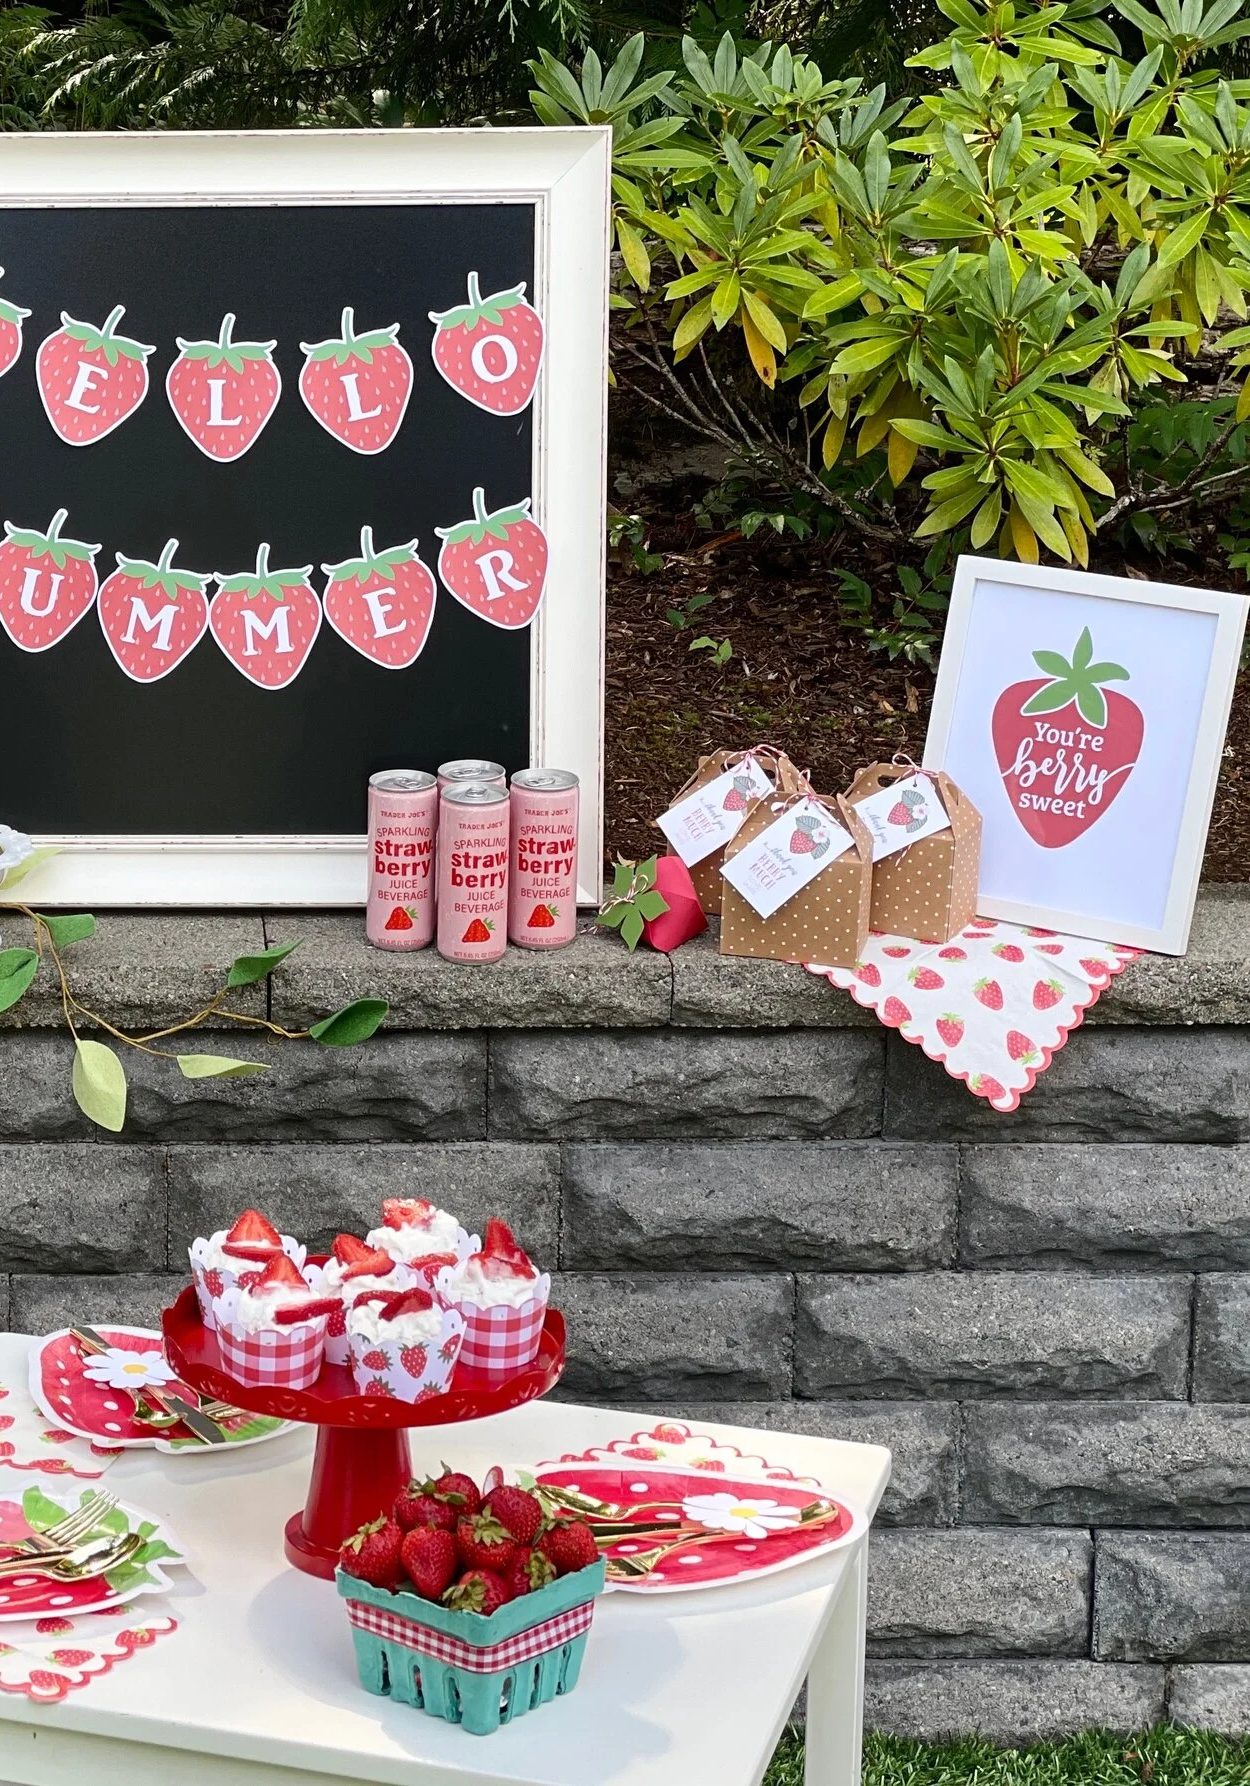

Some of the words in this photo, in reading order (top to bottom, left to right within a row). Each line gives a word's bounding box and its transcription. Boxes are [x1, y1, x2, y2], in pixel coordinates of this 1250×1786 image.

[1034, 721, 1104, 752] You're
[1001, 737, 1137, 805] berry
[1019, 792, 1086, 819] sweet
[380, 810, 406, 818] TRADER
[376, 826, 430, 837] SPARKLING
[520, 825, 573, 836] SPARKLING
[454, 837, 507, 850] SPARKLING
[375, 855, 431, 878] berry
[518, 853, 574, 876] berry
[389, 880, 418, 889] JUICE
[451, 868, 506, 889] berry
[532, 877, 560, 887] JUICE
[378, 889, 428, 901] BEVERAGE
[467, 890, 496, 901] JUICE
[520, 887, 570, 899] BEVERAGE
[454, 900, 504, 914] BEVERAGE
